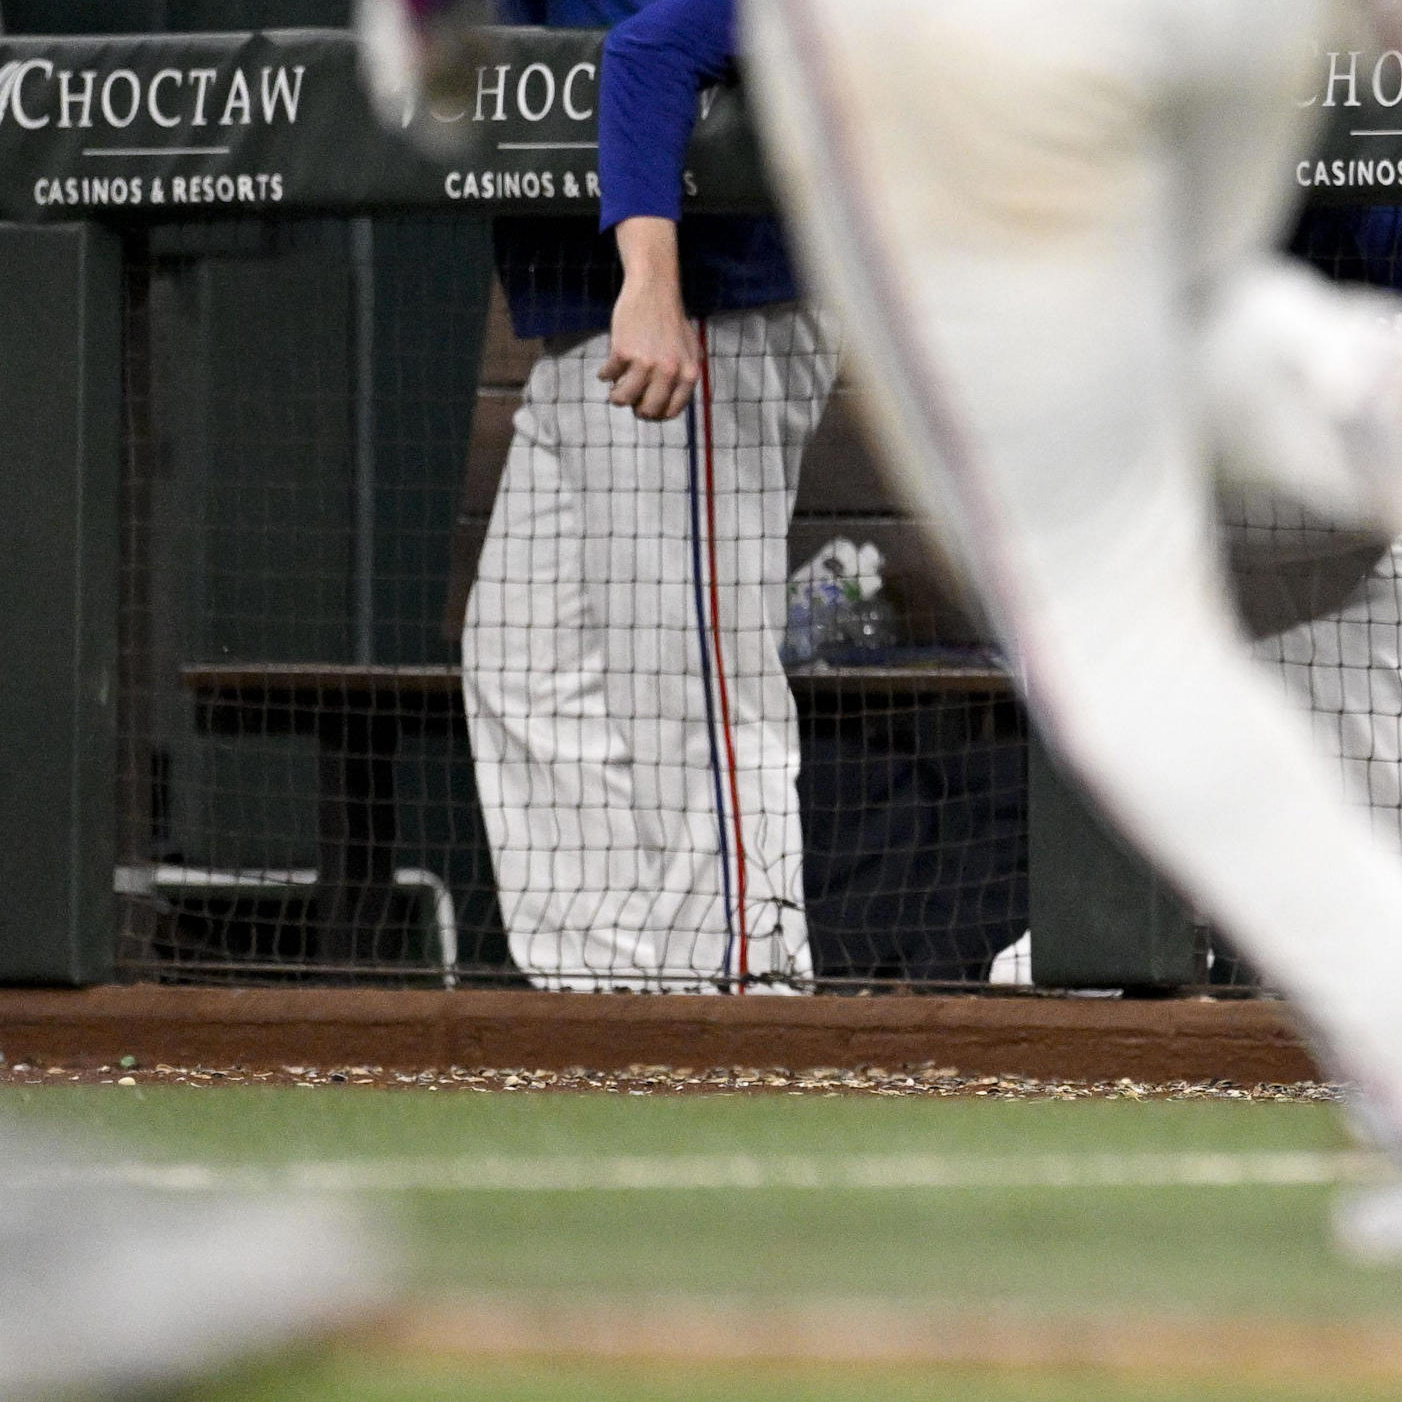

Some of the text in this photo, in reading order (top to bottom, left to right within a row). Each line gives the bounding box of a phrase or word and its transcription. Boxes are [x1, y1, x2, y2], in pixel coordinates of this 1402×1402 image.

[11, 57, 306, 130] CHOCTAW
[34, 173, 284, 206] CASINOS & RESORTS
[444, 170, 556, 200] CASINOS
[562, 170, 580, 199] &
